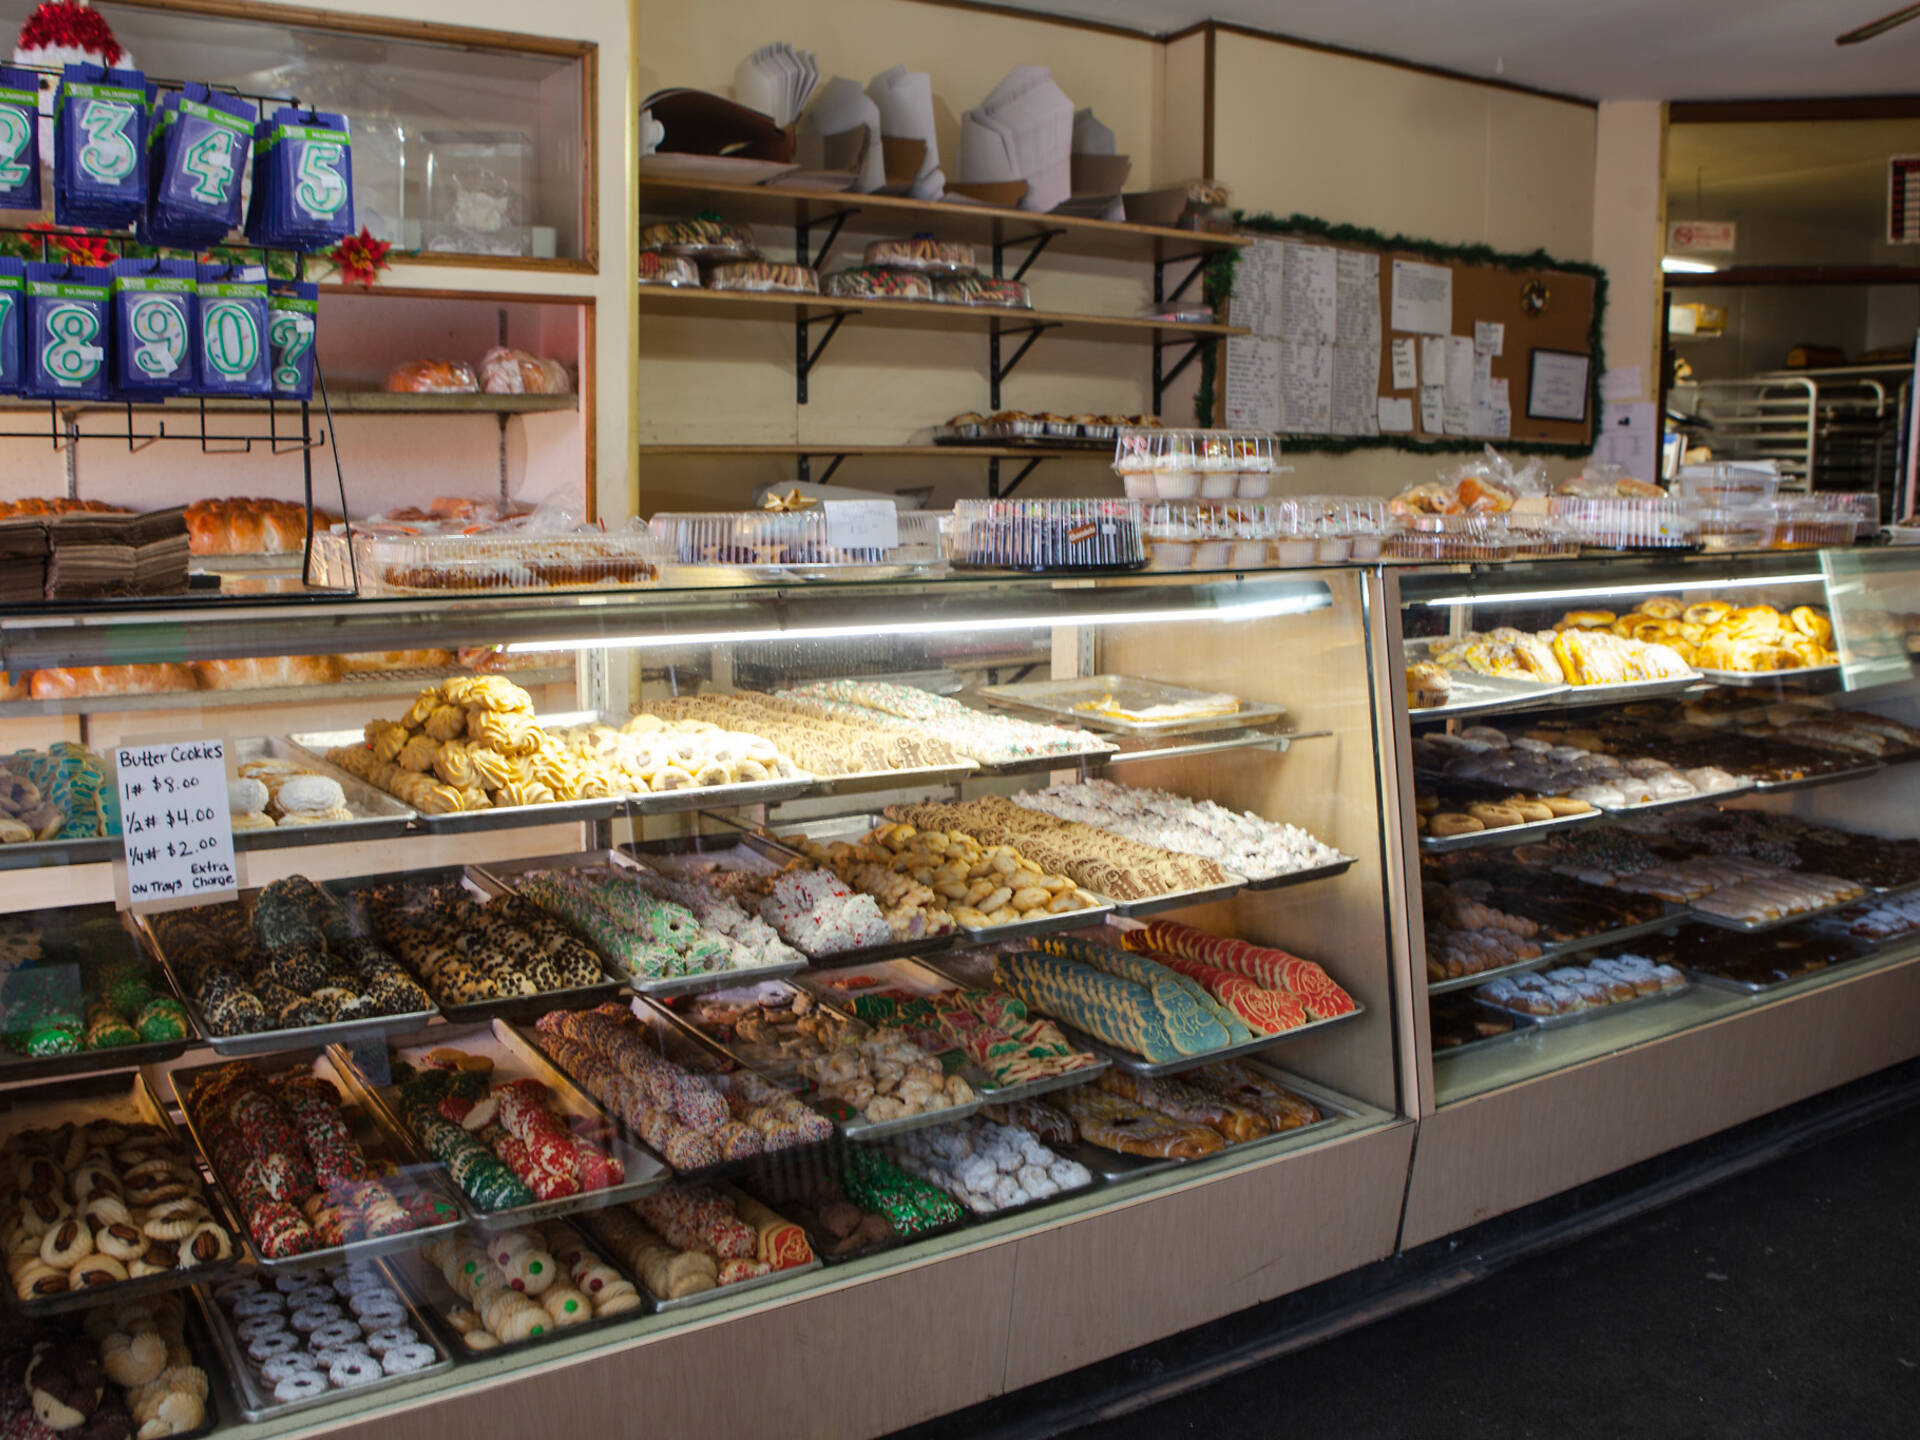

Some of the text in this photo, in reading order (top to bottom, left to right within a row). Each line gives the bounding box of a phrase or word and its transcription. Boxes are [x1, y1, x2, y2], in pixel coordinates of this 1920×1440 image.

[80, 102, 136, 181] 3
[184, 129, 235, 203] 4
[296, 143, 347, 215] 5
[43, 304, 100, 382] 8
[132, 297, 188, 374] 9
[203, 302, 259, 376] 0
[120, 743, 223, 768] Butter Cookies
[125, 776, 200, 800] 1# $8.00
[166, 808, 215, 828] $4.00
[167, 837, 218, 857] $2.00
[191, 861, 230, 875] Extra
[151, 879, 183, 895] Trays
[192, 874, 235, 889] Charge
